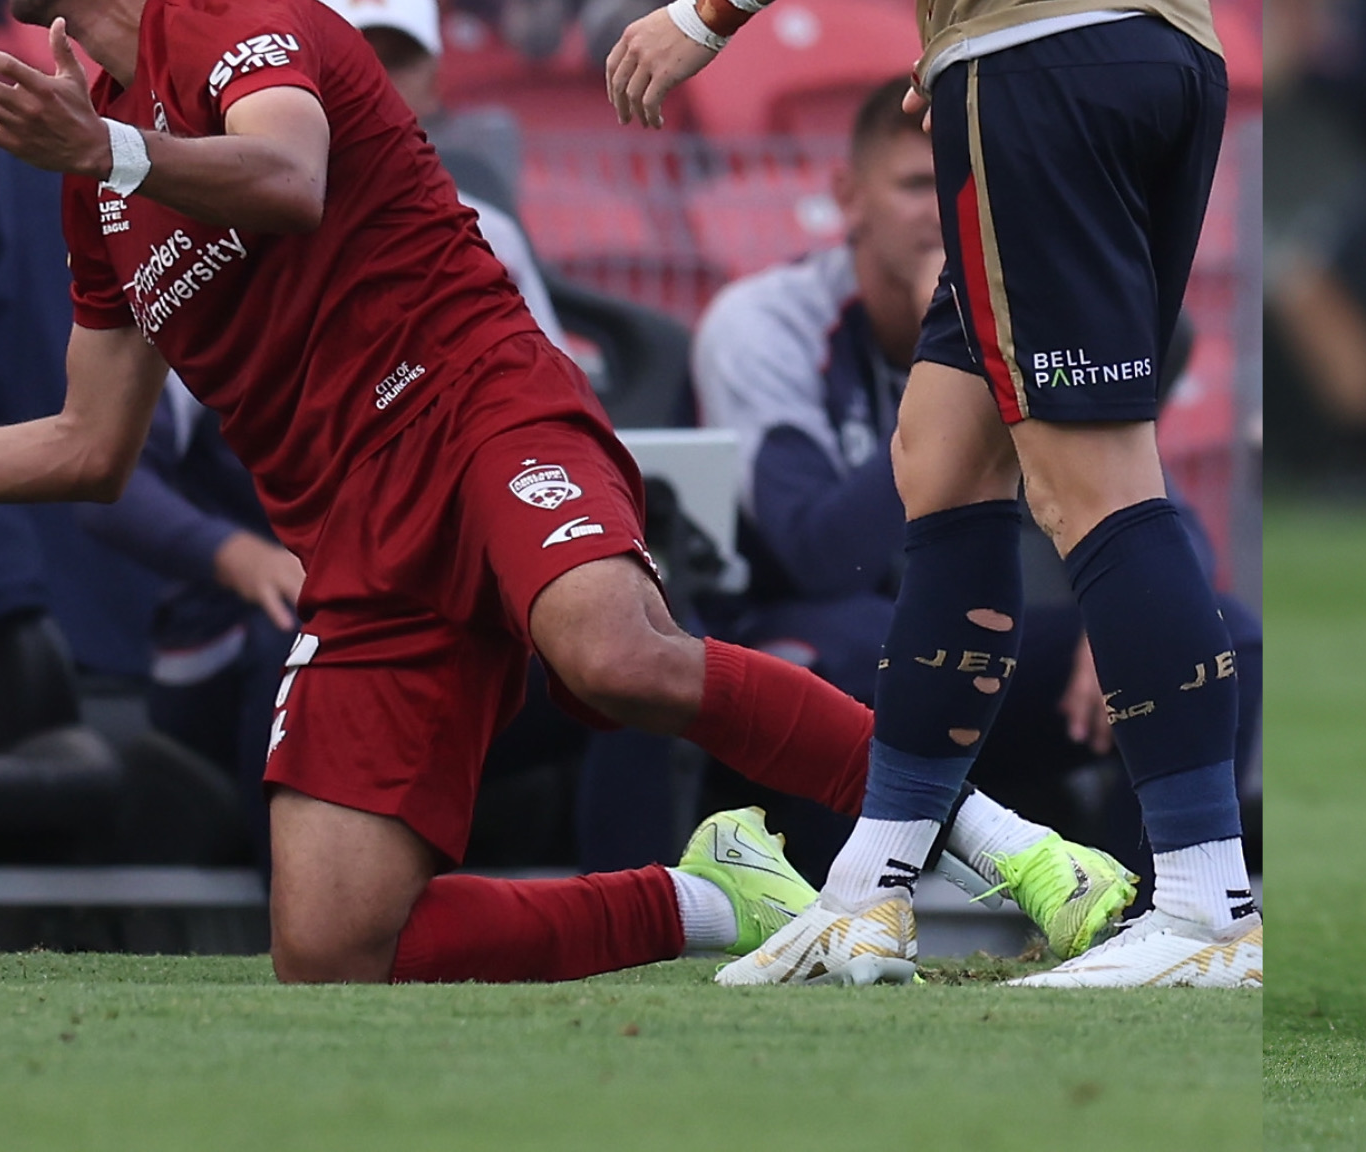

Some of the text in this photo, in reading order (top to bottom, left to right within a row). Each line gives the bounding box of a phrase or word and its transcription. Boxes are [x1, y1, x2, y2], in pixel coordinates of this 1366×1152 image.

[1034, 348, 1092, 369] BELL
[1035, 358, 1152, 388] PARTNERS
[375, 361, 410, 395] CITY OF
[376, 364, 426, 410] CHURCHES
